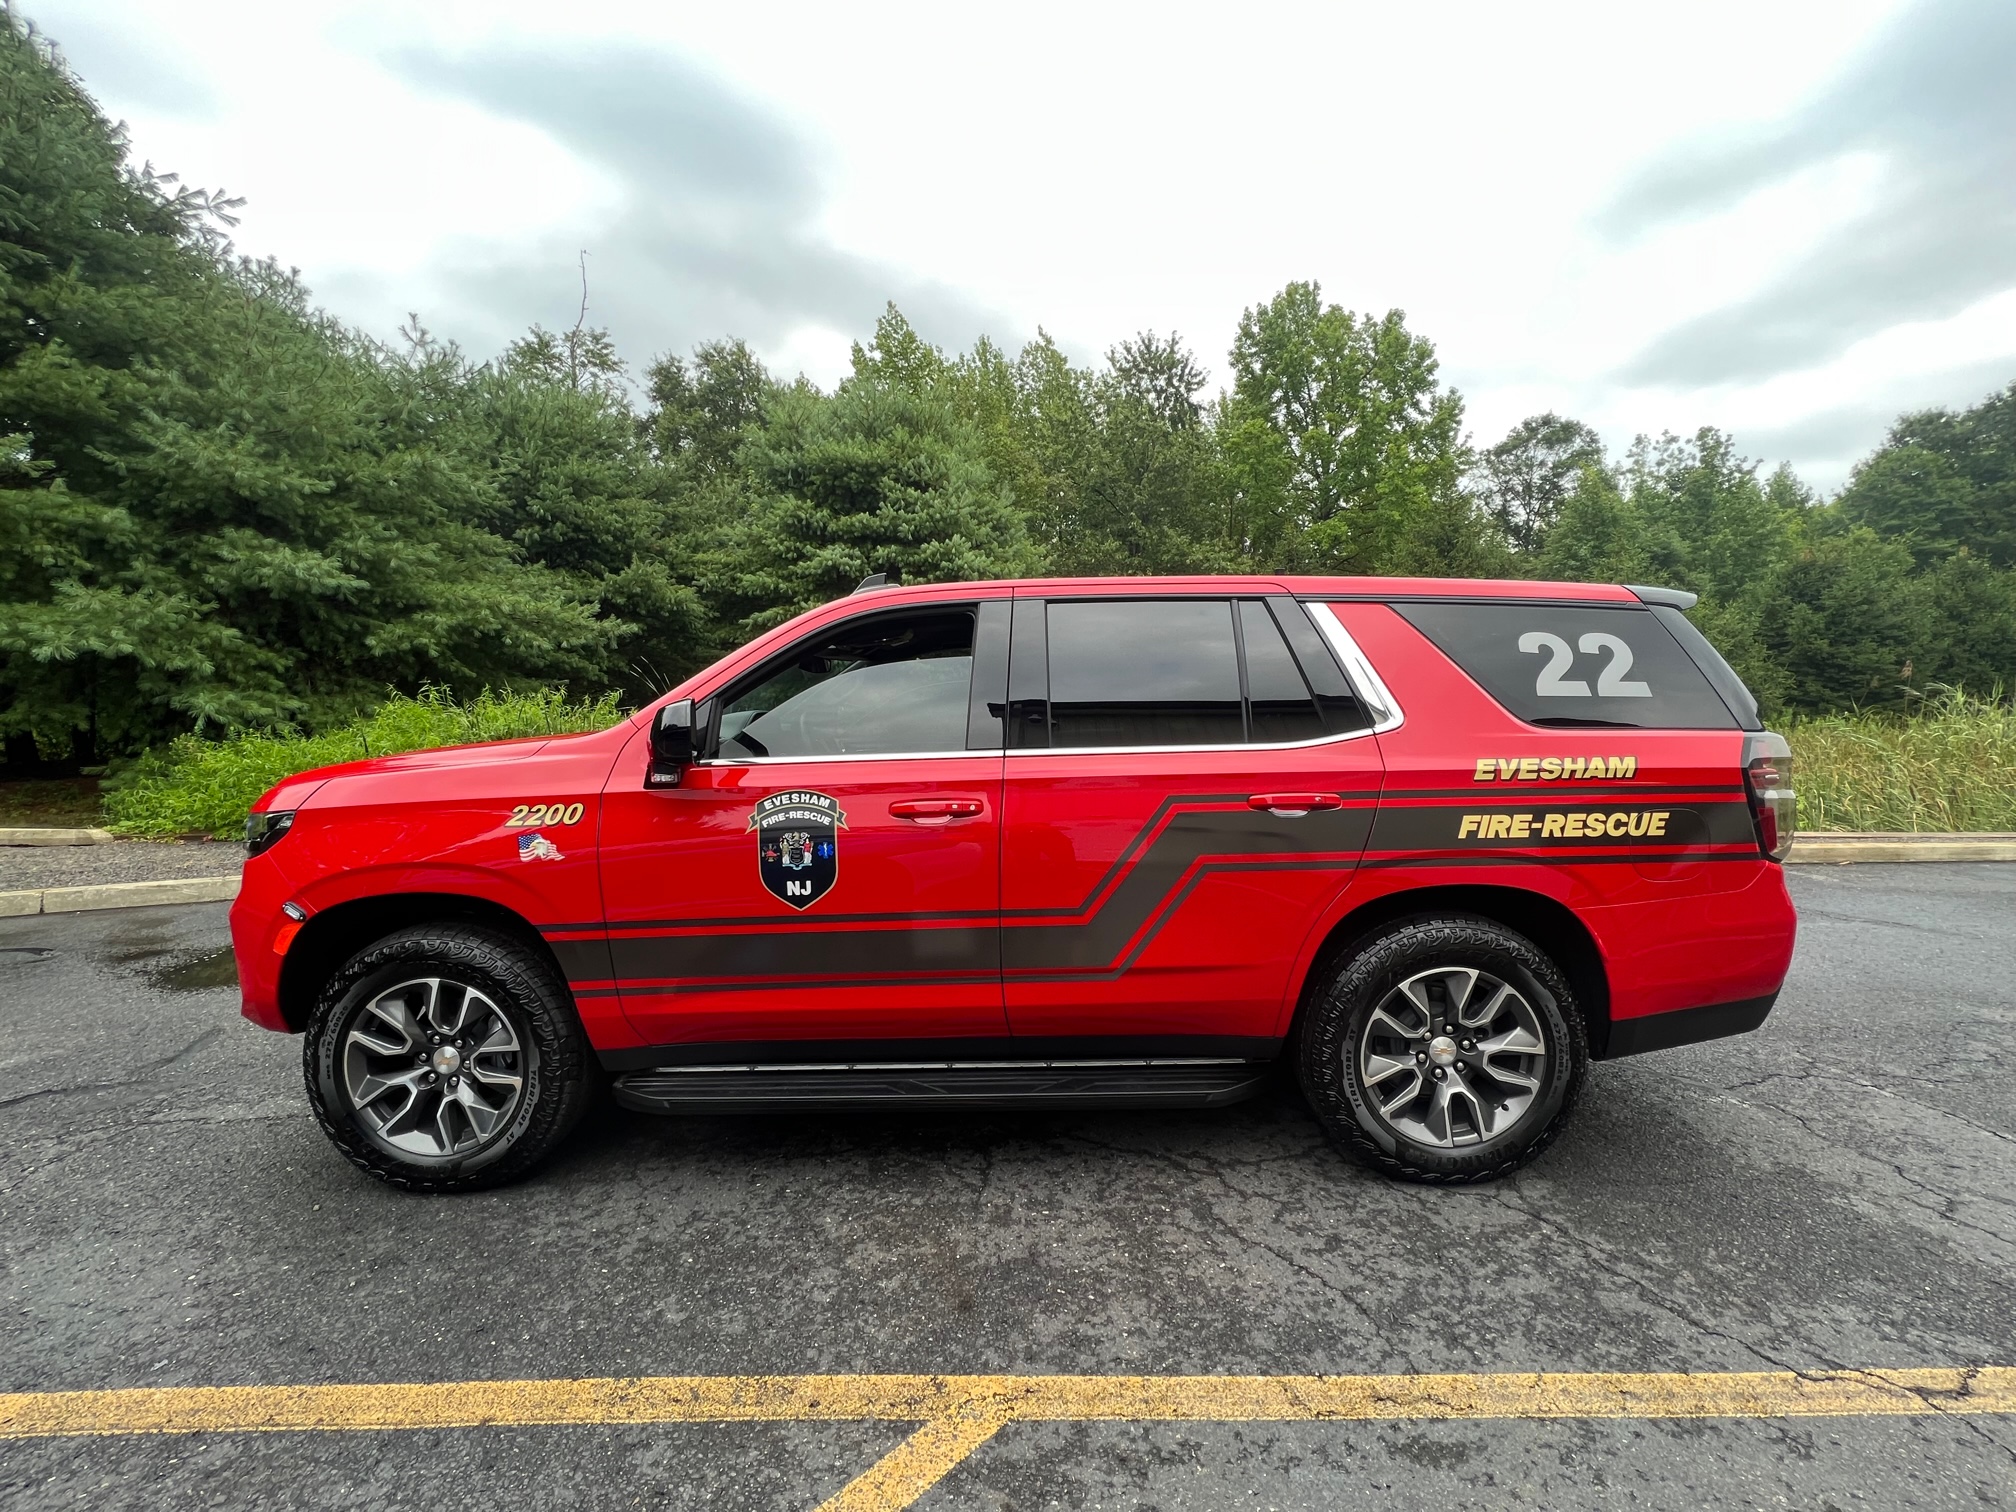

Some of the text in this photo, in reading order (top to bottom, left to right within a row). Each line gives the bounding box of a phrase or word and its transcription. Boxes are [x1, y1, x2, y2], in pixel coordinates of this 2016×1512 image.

[1518, 631, 1653, 697] 22
[1473, 755, 1638, 782] EVESHAM
[763, 793, 831, 810] EVESHAM
[504, 803, 584, 828] 2200
[761, 810, 832, 828] FIRE-RESCUE
[1458, 811, 1671, 840] FIRE-RESCUE
[786, 880, 812, 896] NJ
[1345, 1028, 1361, 1109] TERRITORY AT
[506, 1069, 537, 1145] TERRITORY AT
